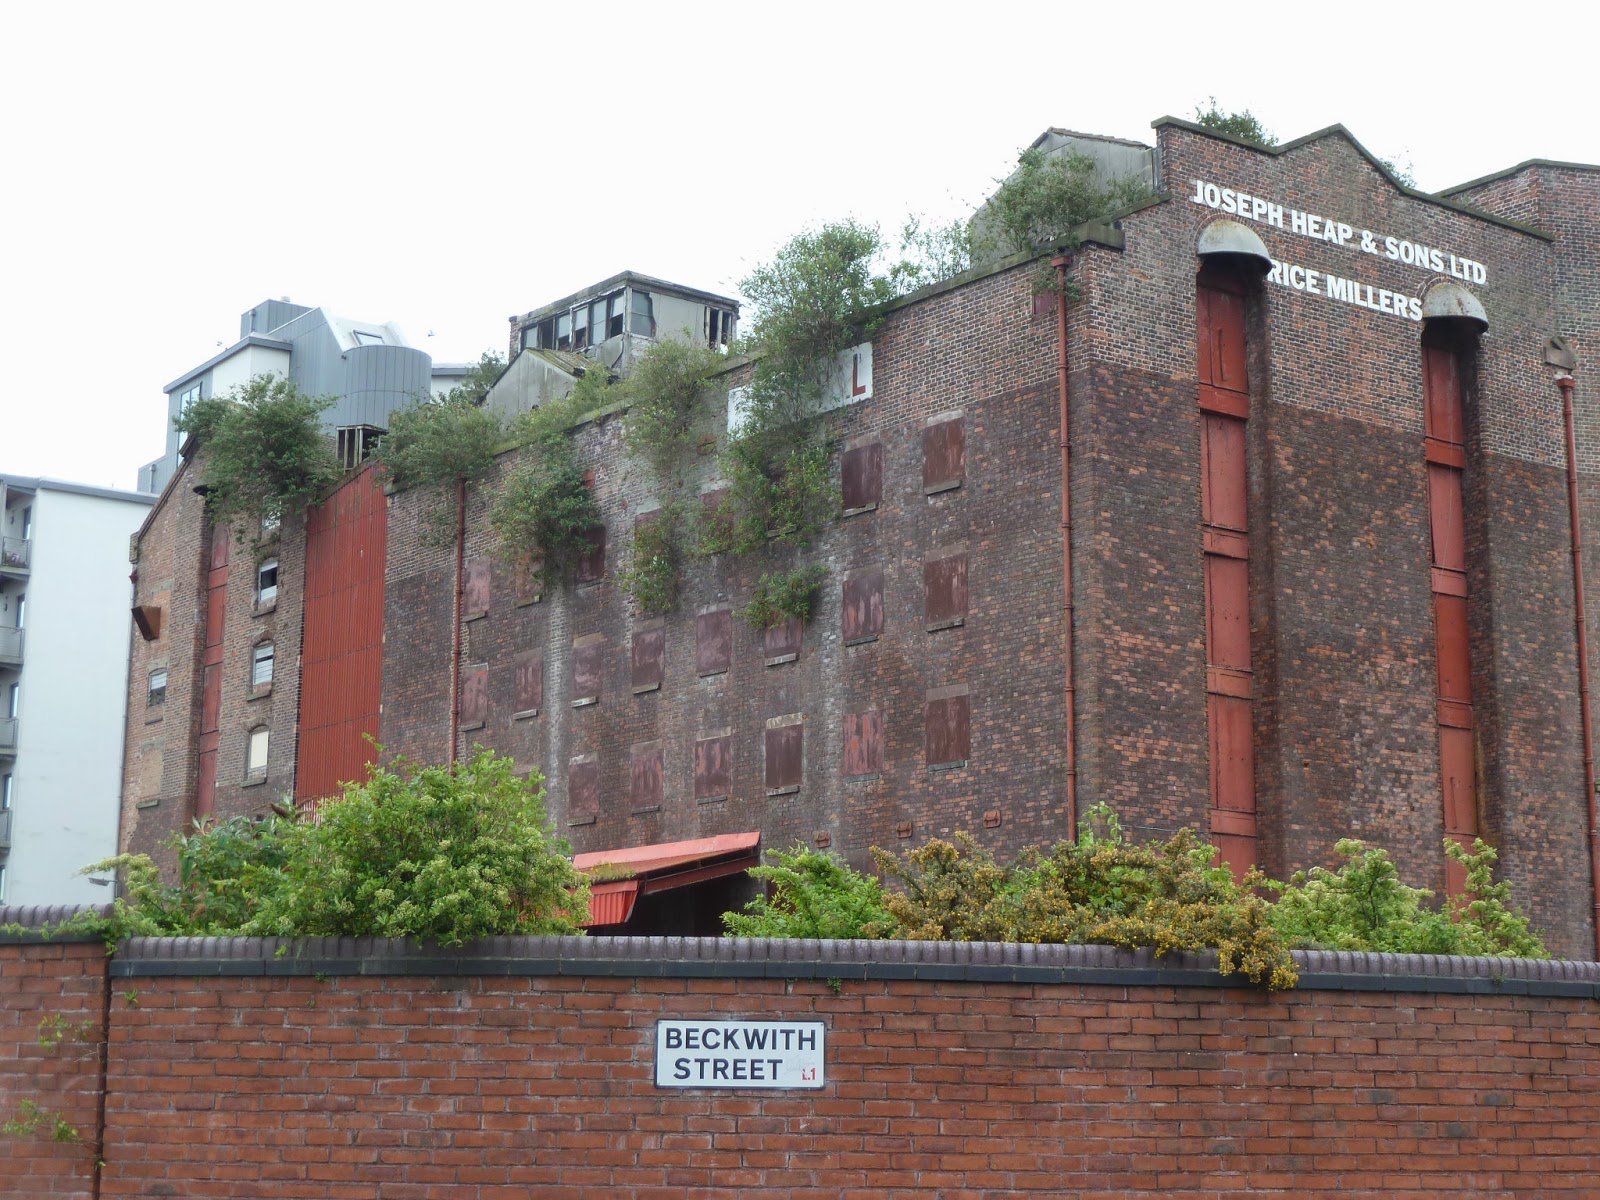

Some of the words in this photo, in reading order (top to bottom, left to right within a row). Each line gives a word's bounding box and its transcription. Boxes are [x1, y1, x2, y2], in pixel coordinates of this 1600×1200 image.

[1190, 180, 1283, 228] JOSEPH
[1291, 210, 1353, 245] HEAP
[1361, 230, 1377, 254] &
[1386, 237, 1444, 273] SONS
[1451, 255, 1487, 285] LTD
[1267, 259, 1321, 295] RICE
[1327, 274, 1423, 321] MILLERS
[665, 1027, 816, 1051] BECKWITH
[673, 1057, 783, 1080] STREET
